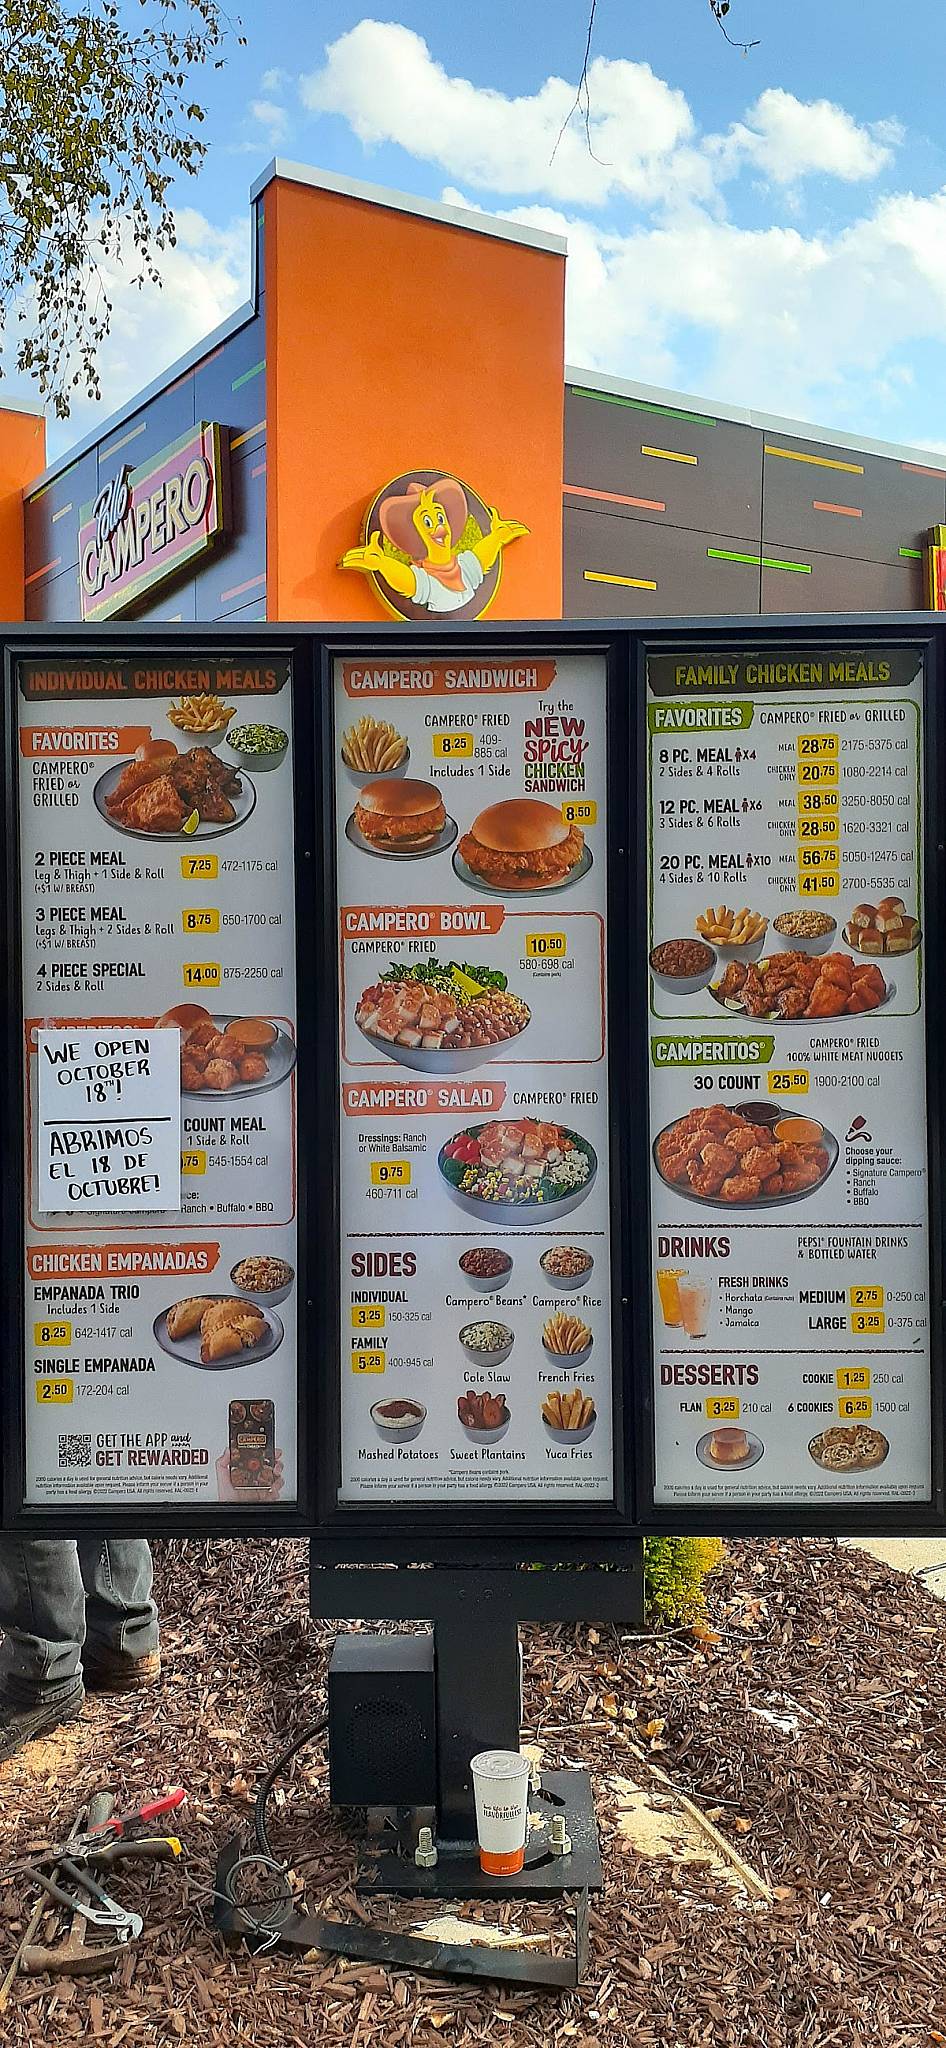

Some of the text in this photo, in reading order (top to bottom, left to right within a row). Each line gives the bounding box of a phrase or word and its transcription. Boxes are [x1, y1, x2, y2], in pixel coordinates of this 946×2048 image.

[82, 457, 210, 595] CAMPERO
[30, 670, 276, 690] INDIVIDUAL CHICKEN MEALS
[445, 669, 537, 688] SANDWICH
[676, 662, 891, 685] FAMILY CHICKEN MEALS
[538, 700, 573, 714] Try the
[482, 714, 510, 726] FRIED
[655, 708, 742, 727] FAVORITES
[525, 717, 585, 737] NEW
[32, 732, 119, 750] FAVORITES
[443, 739, 466, 752] 8.25
[480, 735, 501, 744] 409-
[802, 738, 834, 754] 28.75
[841, 739, 908, 750] 2175-5375 cal
[474, 747, 507, 757] 885 cal
[660, 749, 733, 763] 8 PC. MEAL
[524, 762, 584, 779] CHICKEN
[803, 766, 835, 781] 20.75
[33, 778, 80, 791] FRIED or
[525, 779, 585, 792] SANDWICH
[33, 794, 79, 806] GRILLED
[803, 794, 837, 810] 38.50
[566, 807, 590, 820] 8.50
[660, 800, 739, 814] 12 PC. MEAL
[802, 822, 835, 836] 28.50
[35, 851, 126, 865] 2 PIECE MEAL
[660, 855, 744, 869] 20 PC. MEAL
[803, 851, 836, 865] 56.75
[189, 860, 211, 873] 7.25
[222, 859, 277, 871] 472-1175 cal
[803, 878, 834, 891] 41.50
[36, 907, 126, 921] 3 PIECE MEAL
[222, 914, 281, 925] 650-1700 cal
[441, 912, 490, 929] BOWL
[188, 915, 211, 928] 8.75
[531, 939, 561, 952] 10.50
[37, 963, 145, 977] 4 PIECE SPECIAL
[520, 959, 574, 969] 580-698 cal
[186, 968, 218, 982] 14.00
[223, 967, 283, 978] 875-2250 cal
[44, 1040, 149, 1064] WE OPEN
[57, 1059, 150, 1085] OCTOBER
[694, 1076, 760, 1090] 30 COUNT
[773, 1075, 806, 1089] 25.50
[438, 1089, 493, 1106] SALAD
[184, 1117, 266, 1132] COUNT MEAL
[50, 1127, 152, 1156] ABRIMOS
[846, 1147, 892, 1157] Choose your
[50, 1154, 148, 1179] EL 18 DE
[209, 1156, 268, 1166] 545-1554 cal
[846, 1156, 873, 1166] dipping
[380, 1167, 402, 1181] 9.75
[217, 1203, 245, 1212] Buffalo
[256, 1203, 273, 1211] BBQ
[853, 1198, 869, 1206] BBQ
[658, 1237, 730, 1258] DRINKS
[32, 1252, 208, 1272] CHICKEN EMPANADAS
[351, 1252, 417, 1277] SIDES
[719, 1277, 788, 1287] FRESH DRINKS
[34, 1285, 140, 1301] EMPANADA TRIO
[351, 1291, 408, 1302] INDIVIDUAL
[800, 1291, 846, 1304] MEDIUM
[856, 1291, 877, 1303] 2.75
[47, 1304, 120, 1315] Includes 1 Side
[726, 1307, 753, 1316] Mango
[359, 1311, 380, 1324] 3.25
[725, 1318, 759, 1327] Jamaica
[809, 1318, 846, 1330] LARGE
[857, 1317, 879, 1329] 3.25
[42, 1328, 65, 1341] 8.25
[75, 1327, 132, 1338] 642-1417 cal
[352, 1337, 388, 1349] FAMILY
[34, 1358, 155, 1373] SINGLE EMPANADA
[359, 1357, 380, 1369] 5.25
[464, 1372, 511, 1382] Cole Slaw
[538, 1371, 594, 1382] French Fries
[661, 1364, 759, 1386] DESSERTS
[803, 1373, 834, 1383] COOKIE
[844, 1372, 865, 1385] 1.25
[43, 1385, 67, 1399] 2.50
[76, 1385, 129, 1396] 172-204 cal
[680, 1402, 702, 1413] FLAN
[713, 1402, 735, 1415] 3.25
[788, 1402, 833, 1412] 6 COOKIES
[846, 1402, 867, 1414] 6.25
[96, 1432, 191, 1447] GET THE APP and
[96, 1449, 209, 1466] GET REWARDED
[359, 1449, 439, 1460] Mashed Potatoes
[450, 1449, 525, 1460] Sweet Plantains
[545, 1449, 593, 1459] Yuca Fries
